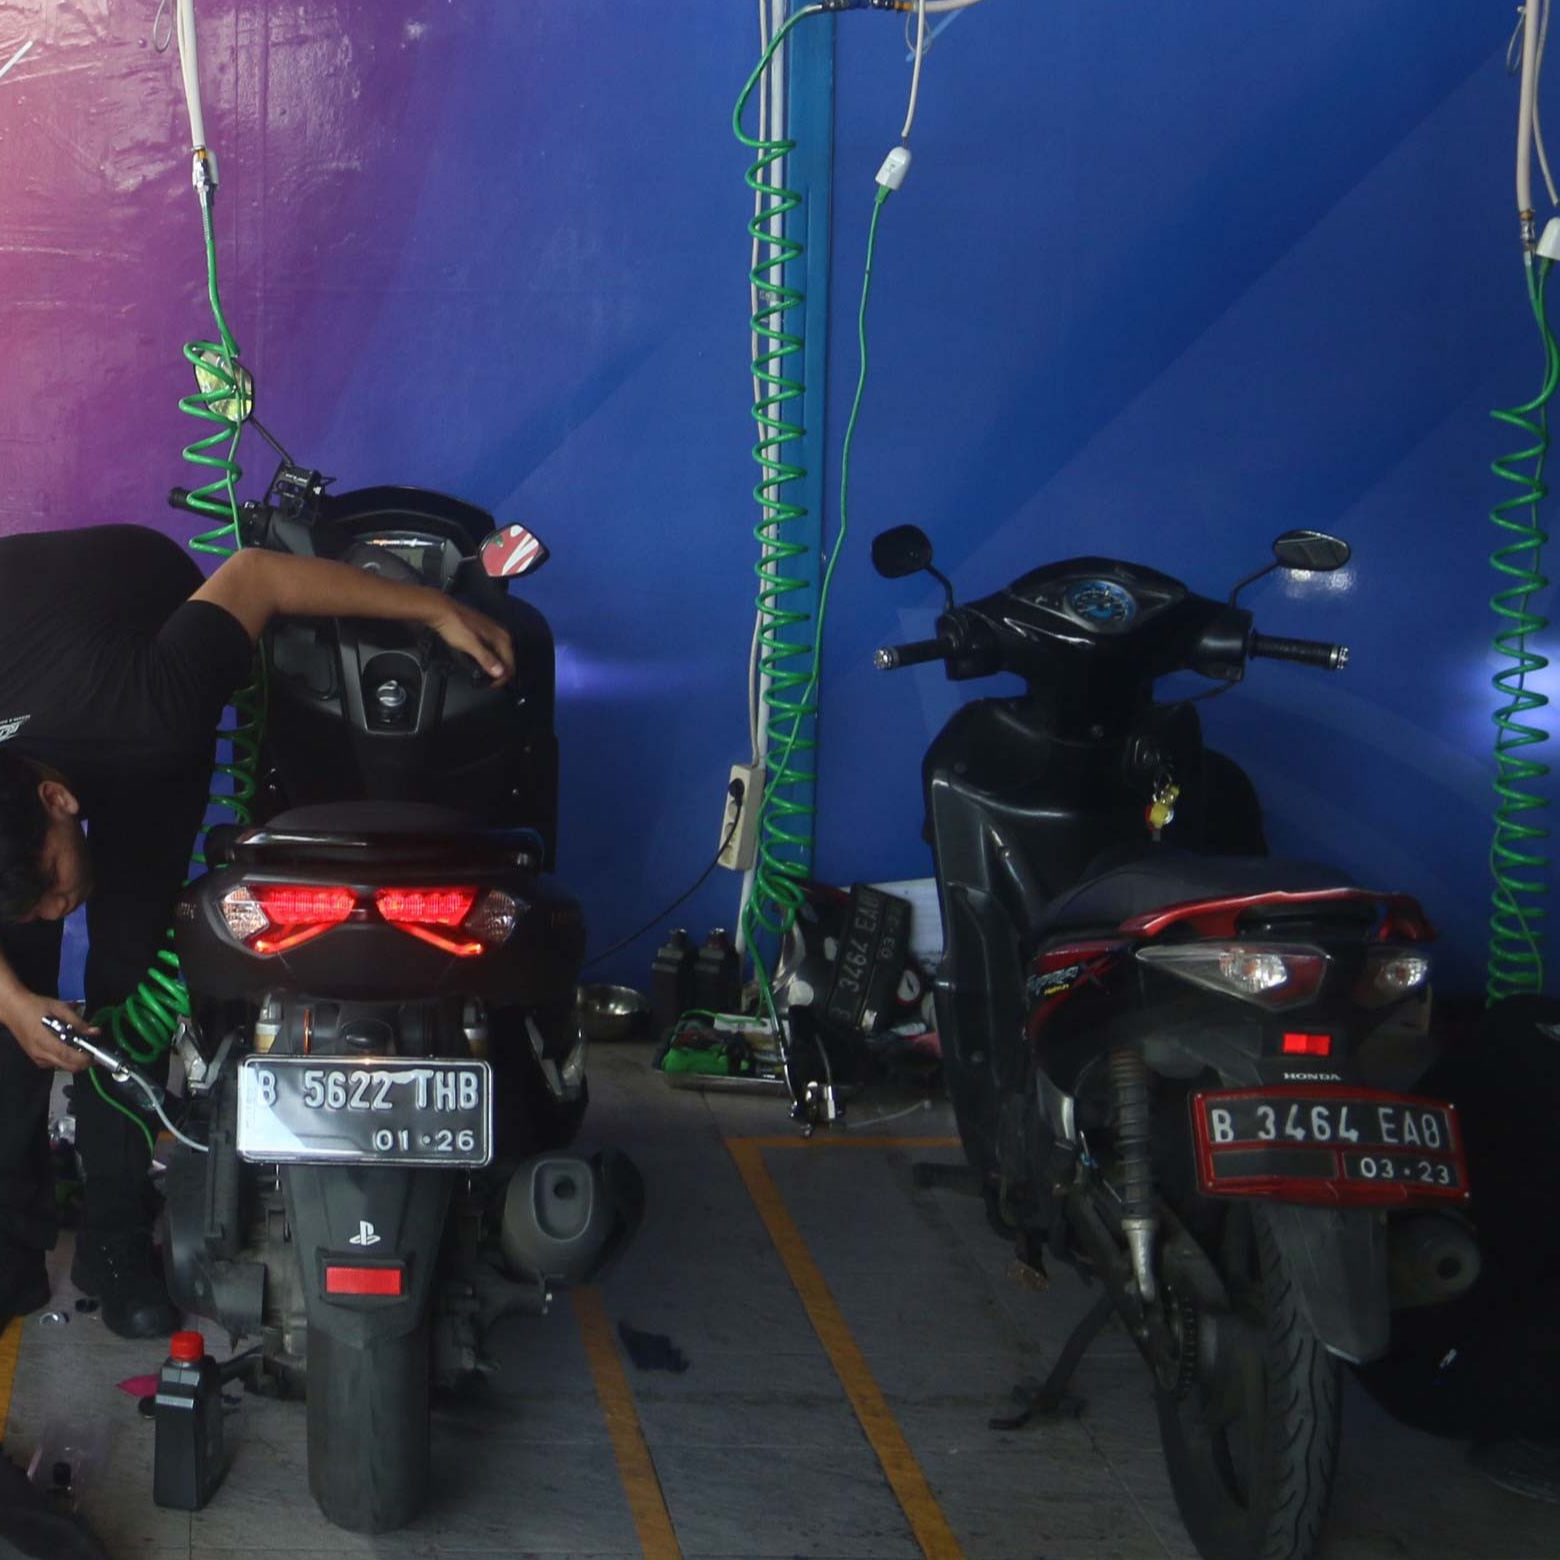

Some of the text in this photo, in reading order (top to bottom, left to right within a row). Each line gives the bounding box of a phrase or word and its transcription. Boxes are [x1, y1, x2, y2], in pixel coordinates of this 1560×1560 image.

[840, 935, 869, 992] 3464
[257, 1070, 480, 1110] B 5622 THB
[1283, 1072, 1342, 1081] HONDA
[1212, 1109, 1235, 1143] B
[1256, 1104, 1360, 1142] 3464
